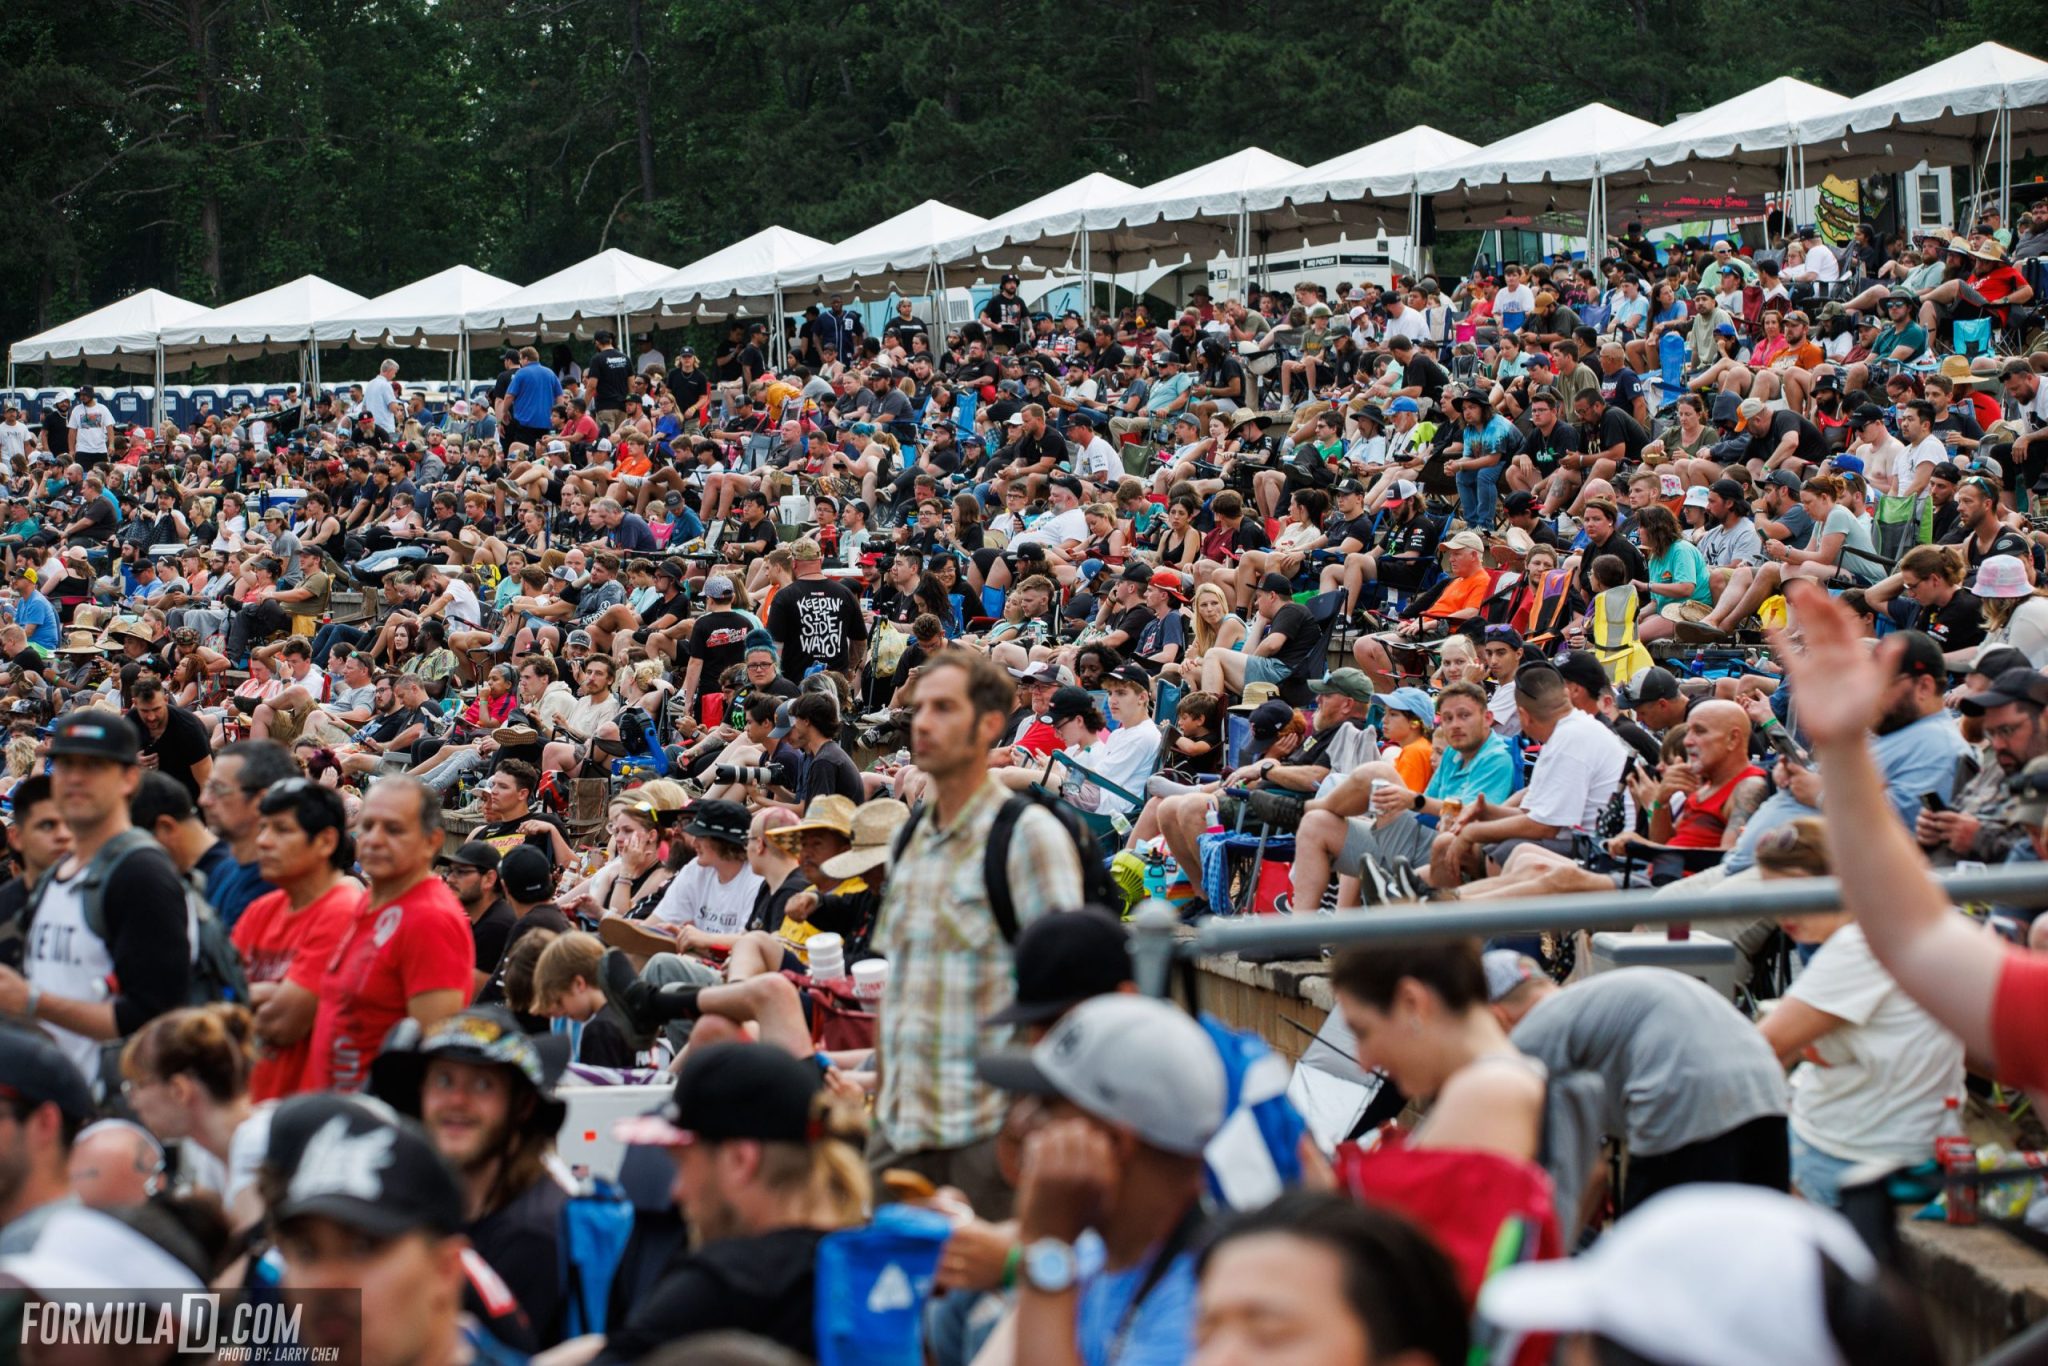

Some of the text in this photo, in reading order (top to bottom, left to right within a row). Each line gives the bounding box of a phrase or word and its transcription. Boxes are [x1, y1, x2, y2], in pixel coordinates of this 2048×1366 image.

[801, 614, 839, 636] SIDE
[812, 610, 830, 621] IT
[800, 621, 842, 657] WAYS!
